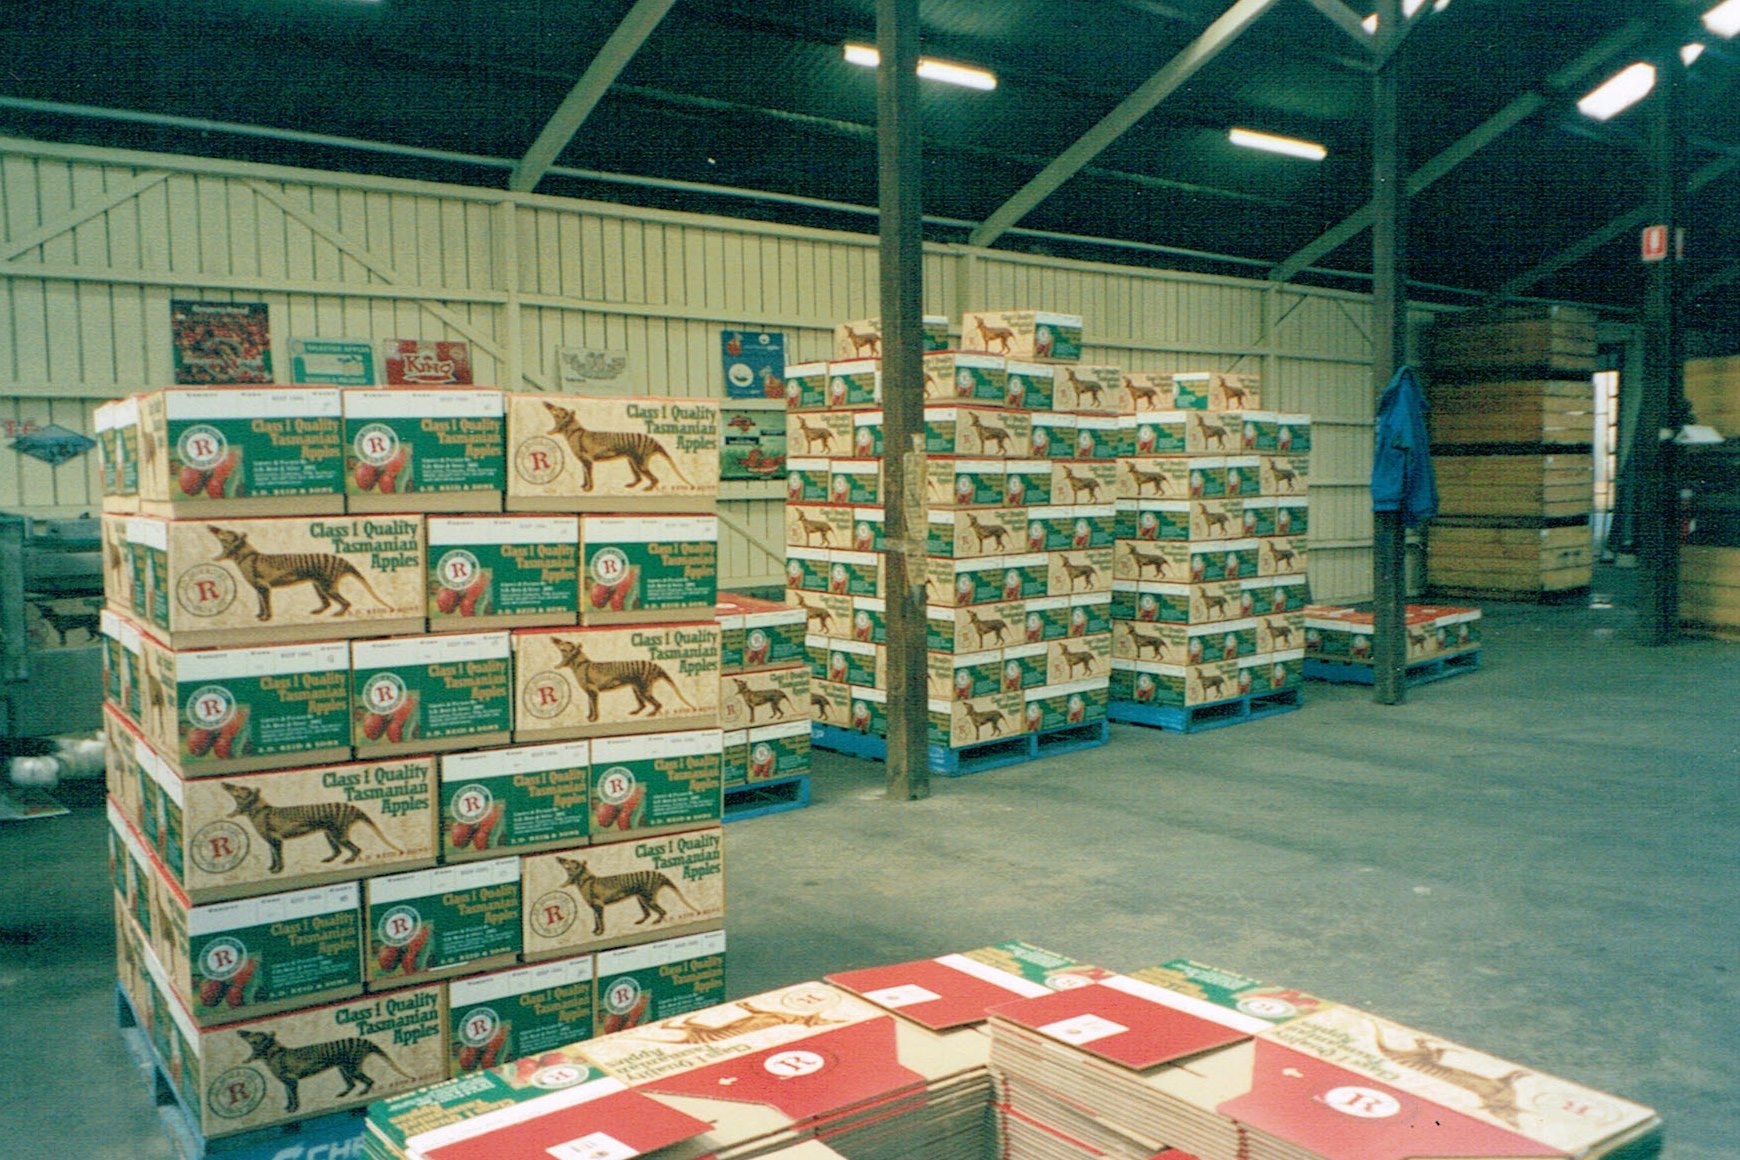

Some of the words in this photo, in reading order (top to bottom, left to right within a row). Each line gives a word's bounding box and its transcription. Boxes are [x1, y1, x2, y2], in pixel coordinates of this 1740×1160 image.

[406, 355, 452, 375] KING
[626, 404, 658, 419] Class
[670, 405, 716, 422] Quality
[251, 418, 283, 432] Class
[294, 417, 338, 433] Quality
[421, 418, 449, 431] Class
[459, 418, 499, 433] Quality
[644, 419, 715, 435] Tasmanian
[268, 431, 339, 445] Tasmanian
[368, 437, 385, 452] R
[436, 430, 500, 443] Tasmanian
[676, 435, 716, 453] Apples
[193, 439, 212, 455] R
[300, 444, 340, 461] Apples
[464, 443, 501, 459] Apples
[530, 451, 550, 470] R
[309, 522, 348, 538] Class
[362, 520, 417, 539] Quality
[331, 534, 417, 553] Tasmanian
[500, 544, 527, 556] Class
[537, 543, 574, 558] Quality
[648, 542, 672, 554] Class
[680, 541, 714, 555] Quality
[370, 552, 419, 572] Apples
[515, 555, 574, 568] Tasmanian
[603, 559, 617, 573] R
[661, 553, 714, 565] Tasmanian
[451, 562, 466, 577] R
[540, 568, 575, 583] Apples
[683, 565, 714, 579] Apples
[194, 580, 219, 601] R
[631, 632, 662, 646] Class
[673, 629, 717, 646] Quality
[648, 642, 717, 660] Tasmanian
[428, 663, 456, 676] Class
[466, 659, 505, 675] Quality
[679, 658, 717, 676] Apples
[260, 676, 291, 689] Class
[302, 671, 345, 688] Quality
[443, 671, 506, 687] Tasmanian
[276, 684, 346, 701] Tasmanian
[376, 686, 393, 701] R
[470, 684, 506, 702] Apples
[537, 686, 557, 705] R
[202, 699, 220, 716] R
[306, 698, 347, 716] Apples
[654, 758, 677, 770] Class
[686, 754, 719, 769] Quality
[322, 772, 360, 787] Class
[374, 764, 427, 785] Quality
[513, 774, 539, 786] Class
[549, 768, 585, 784] Quality
[666, 765, 718, 780] Tasmanian
[343, 777, 427, 801] Tasmanian
[527, 779, 586, 796] Tasmanian
[610, 778, 623, 793] R
[688, 777, 719, 793] Apples
[381, 795, 428, 816] Apples
[464, 796, 480, 811] R
[552, 792, 586, 809] Apples
[207, 837, 232, 858] R
[635, 844, 665, 857] Class
[677, 834, 719, 853] Quality
[652, 845, 719, 869] Tasmanian
[682, 861, 720, 881] Apples
[544, 905, 563, 924] R
[392, 918, 408, 934] R
[214, 950, 232, 967] R
[616, 988, 629, 1003] R
[334, 1008, 372, 1024] Class
[385, 993, 437, 1016] Quality
[356, 1004, 438, 1035] Tasmanian
[472, 1019, 487, 1035] R
[393, 1023, 439, 1045] Apples
[225, 1083, 249, 1104] R
